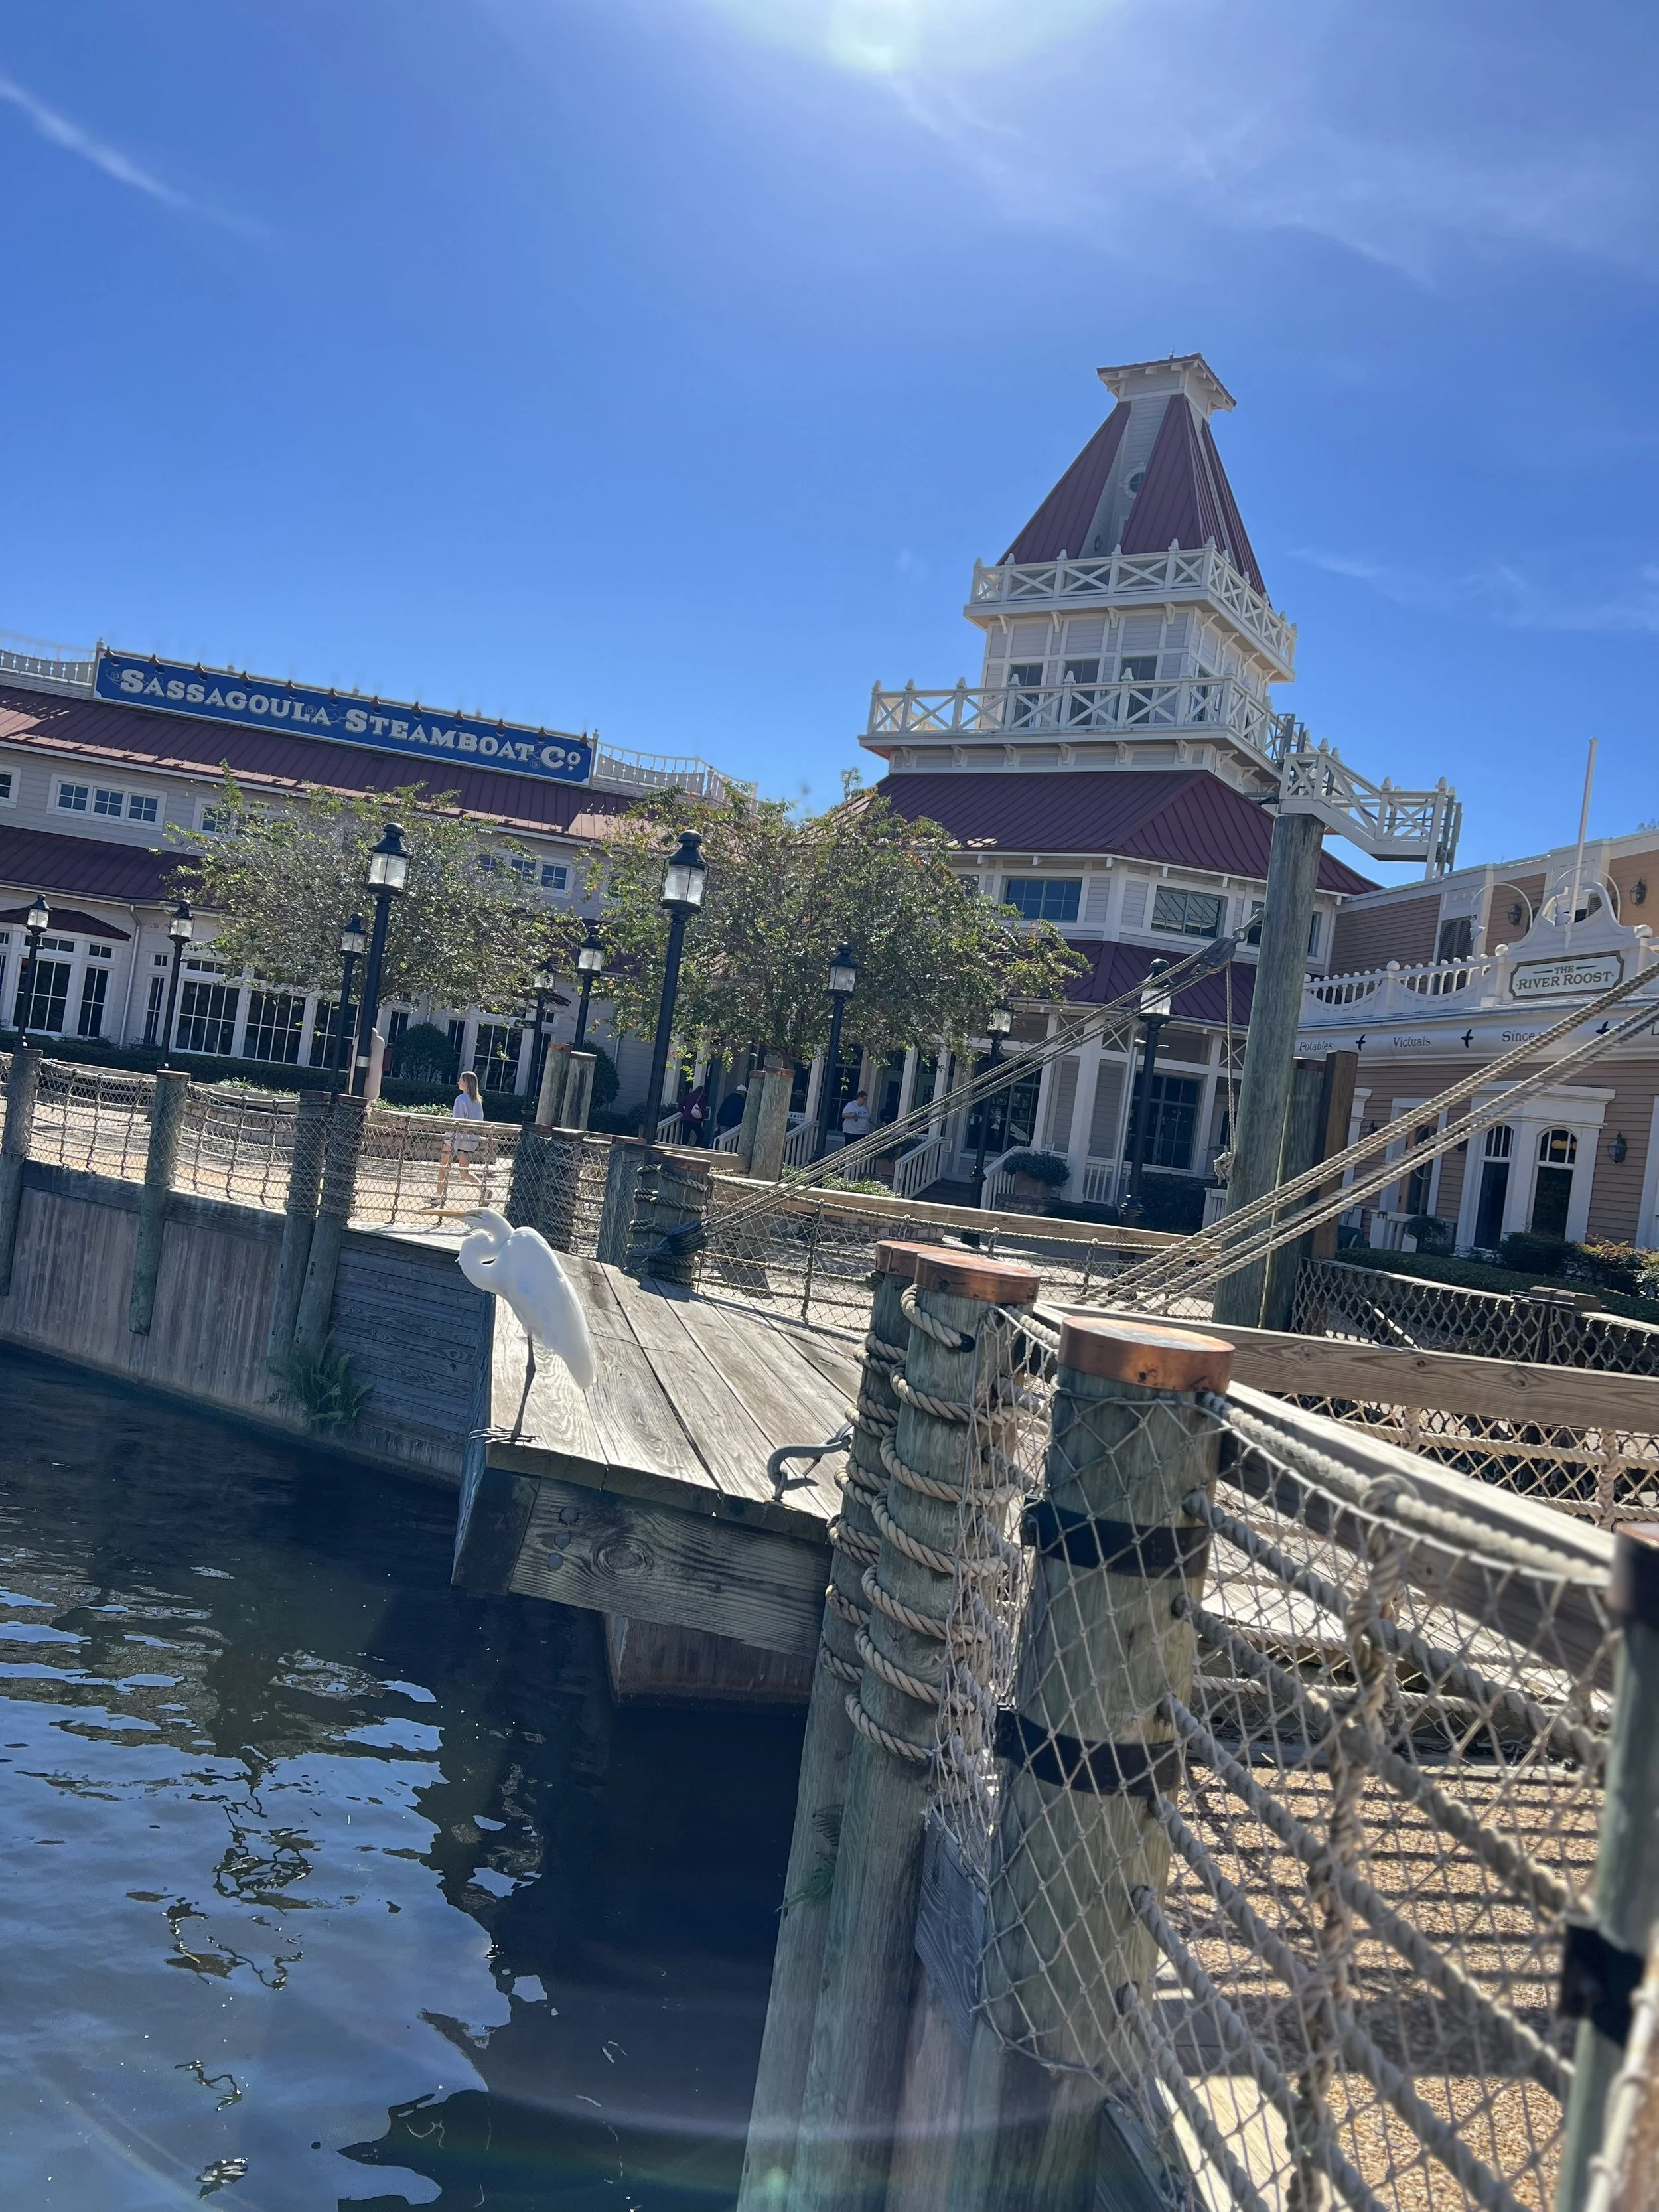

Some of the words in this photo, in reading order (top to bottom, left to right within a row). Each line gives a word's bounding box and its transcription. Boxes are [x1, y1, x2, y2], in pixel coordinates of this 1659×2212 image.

[119, 668, 332, 725] SASSAGOULA
[344, 709, 535, 762] STEAMBOAT
[1554, 966, 1575, 974] THE
[1299, 1041, 1333, 1051] Potables
[1393, 1036, 1431, 1047] Victuals
[1502, 1029, 1535, 1043] Since
